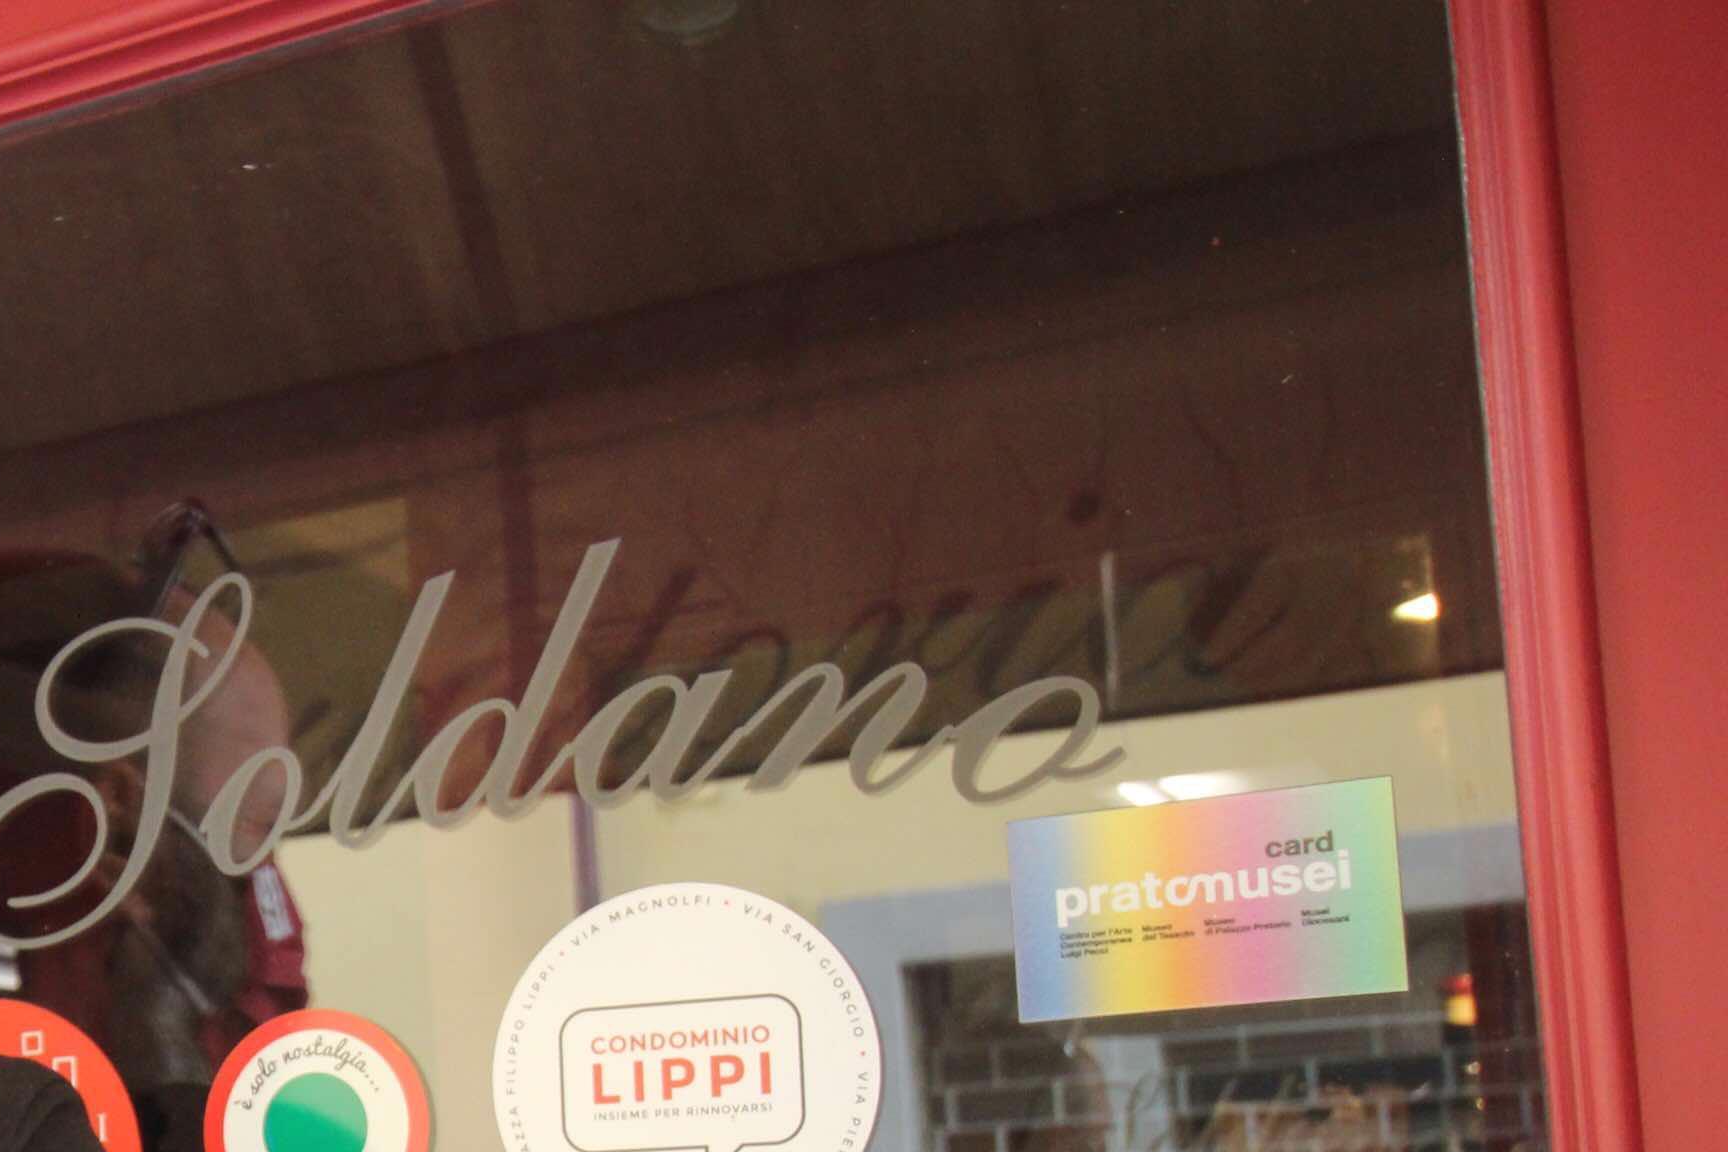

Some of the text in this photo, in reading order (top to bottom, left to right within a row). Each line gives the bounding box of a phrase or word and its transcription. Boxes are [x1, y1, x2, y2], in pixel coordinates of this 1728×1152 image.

[1265, 829, 1334, 858] card
[1056, 850, 1351, 928] pratomusei
[570, 895, 712, 947] VIA MAGNOLFI
[743, 904, 864, 1038] VIA SAN GIORGIO
[506, 1019, 526, 1095] FILIPPO
[523, 963, 555, 1010] LIPPI
[591, 1024, 771, 1055] CONDOMINIO
[248, 1057, 278, 1095] solo
[592, 1051, 772, 1105] LIPPI
[855, 1071, 869, 1105] VIA
[593, 1103, 774, 1121] INSIEME PER RINNOVARSI
